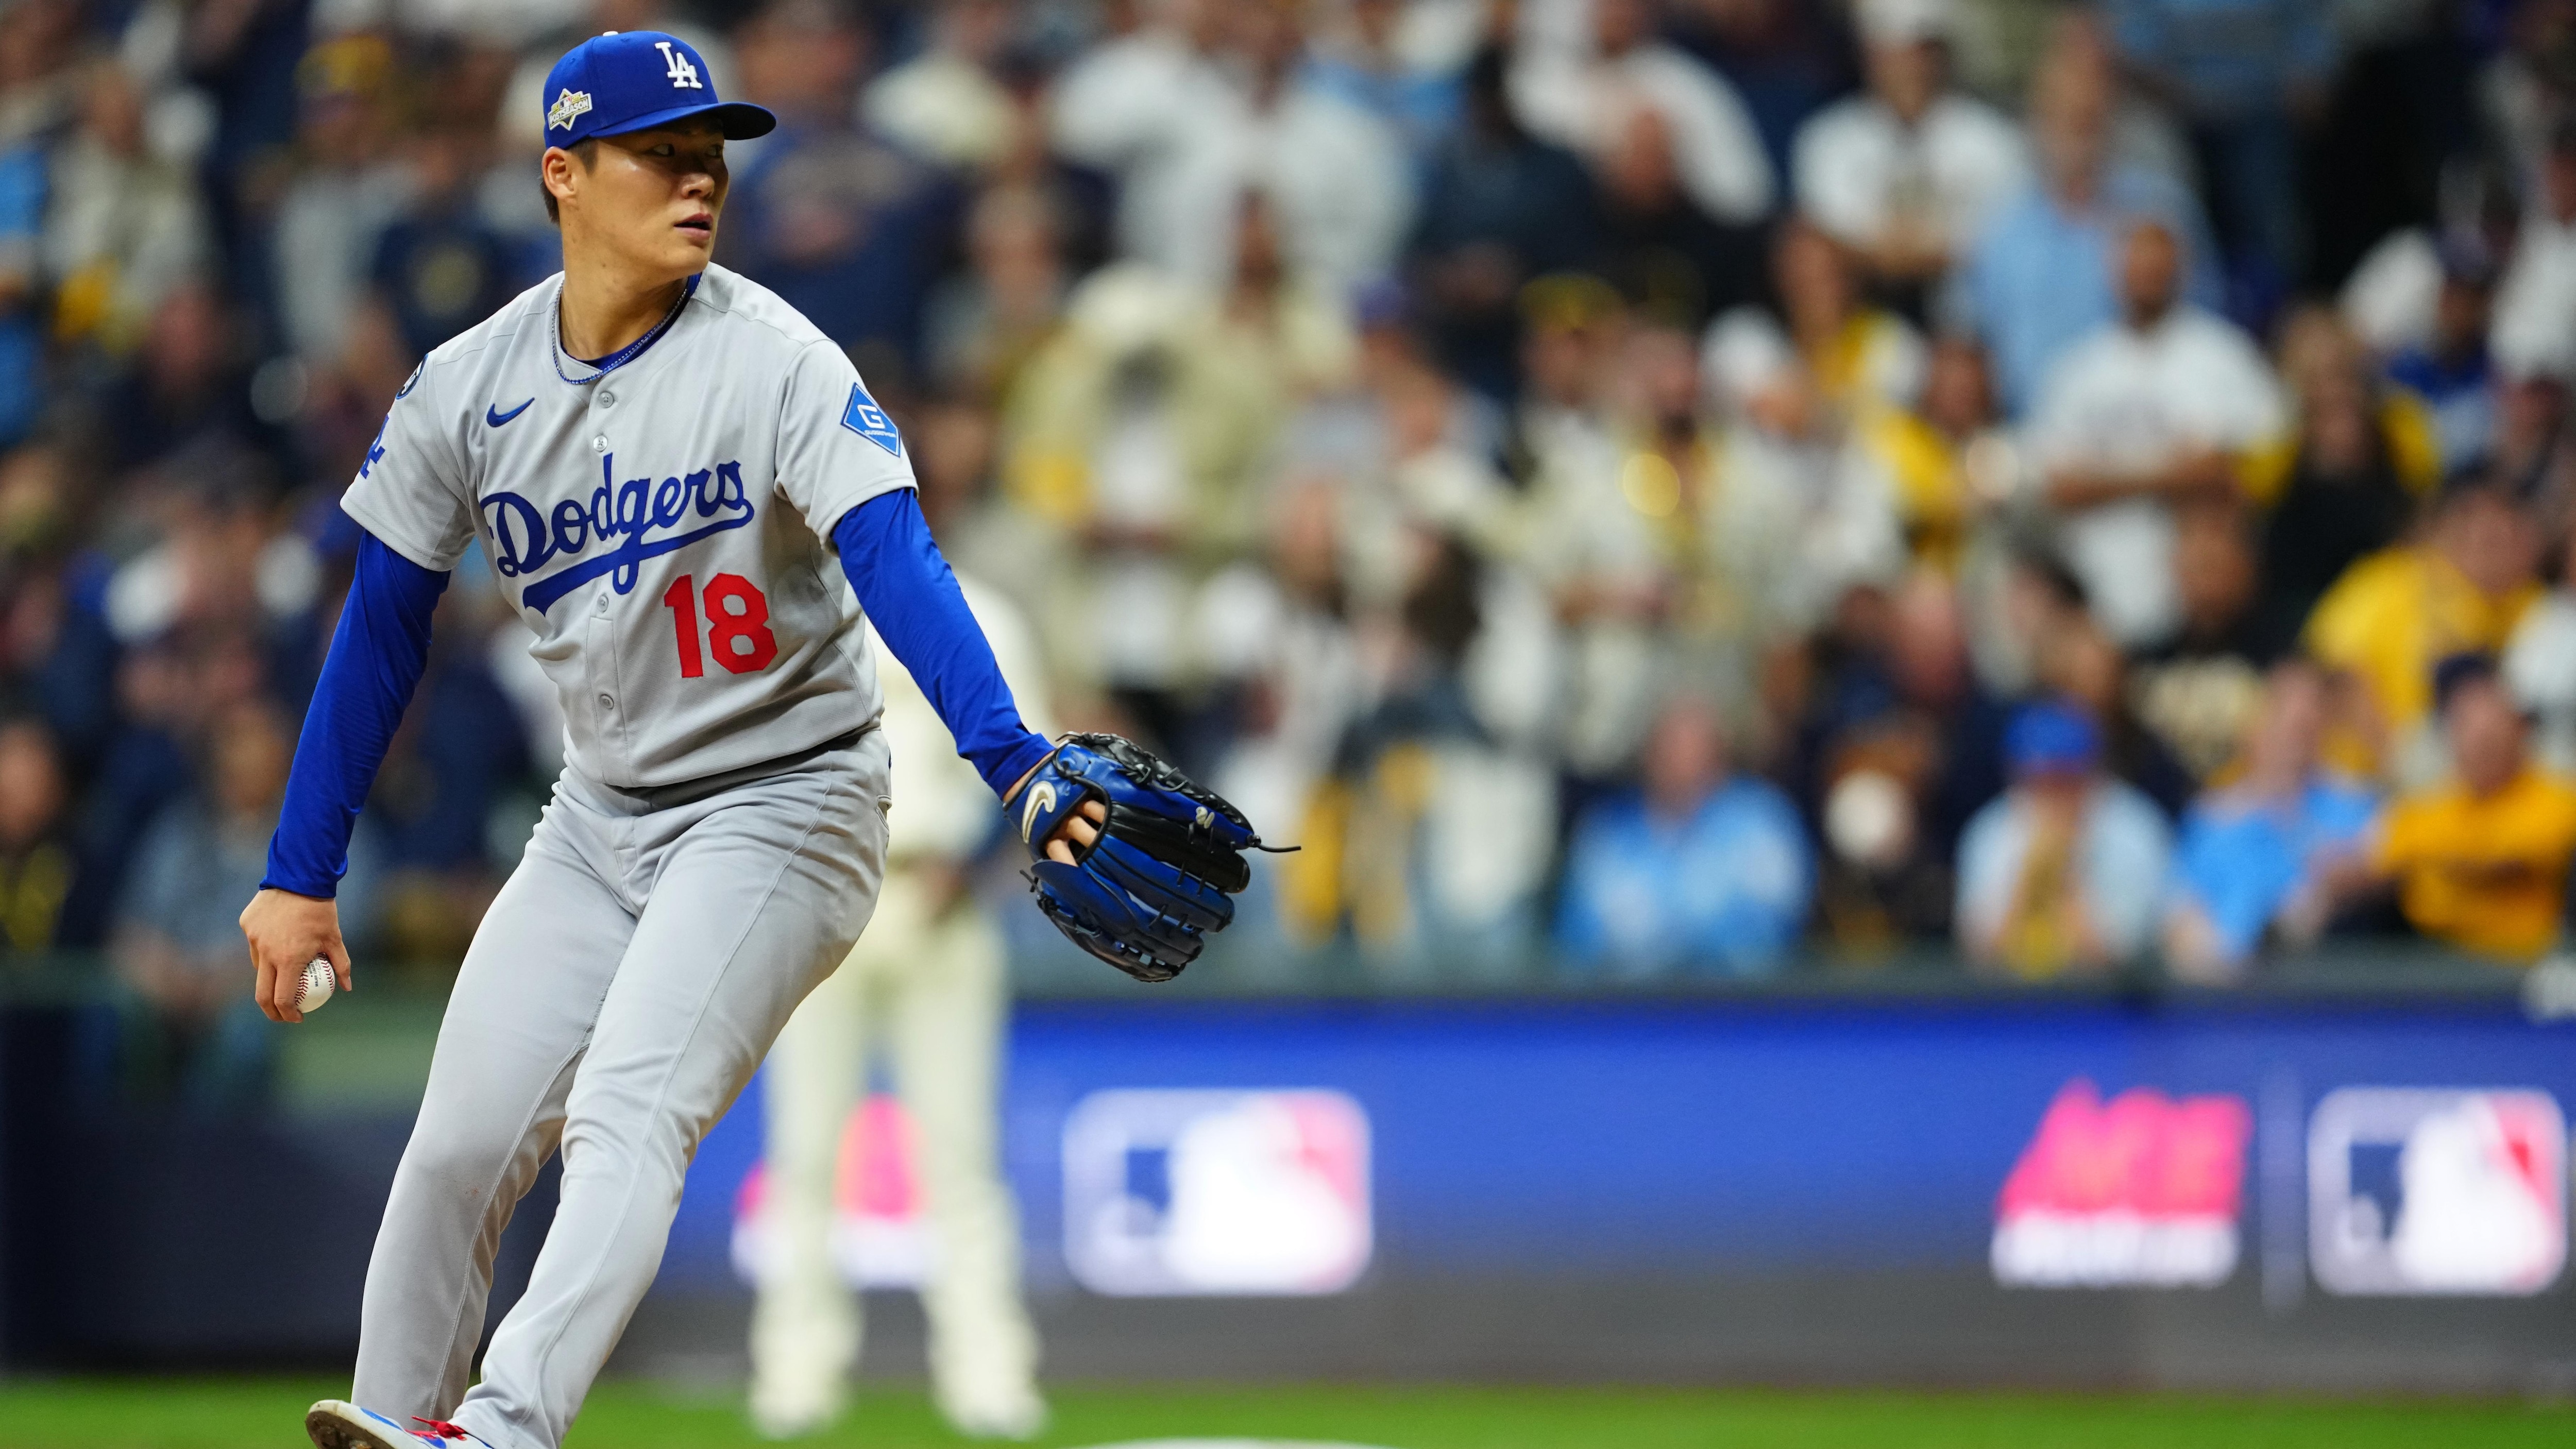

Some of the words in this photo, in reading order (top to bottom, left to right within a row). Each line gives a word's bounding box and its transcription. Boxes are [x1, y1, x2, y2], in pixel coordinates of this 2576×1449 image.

[654, 42, 703, 89] LA
[549, 98, 589, 125] POSTSEASON
[480, 452, 755, 596] Dodgers
[664, 572, 778, 678] 18
